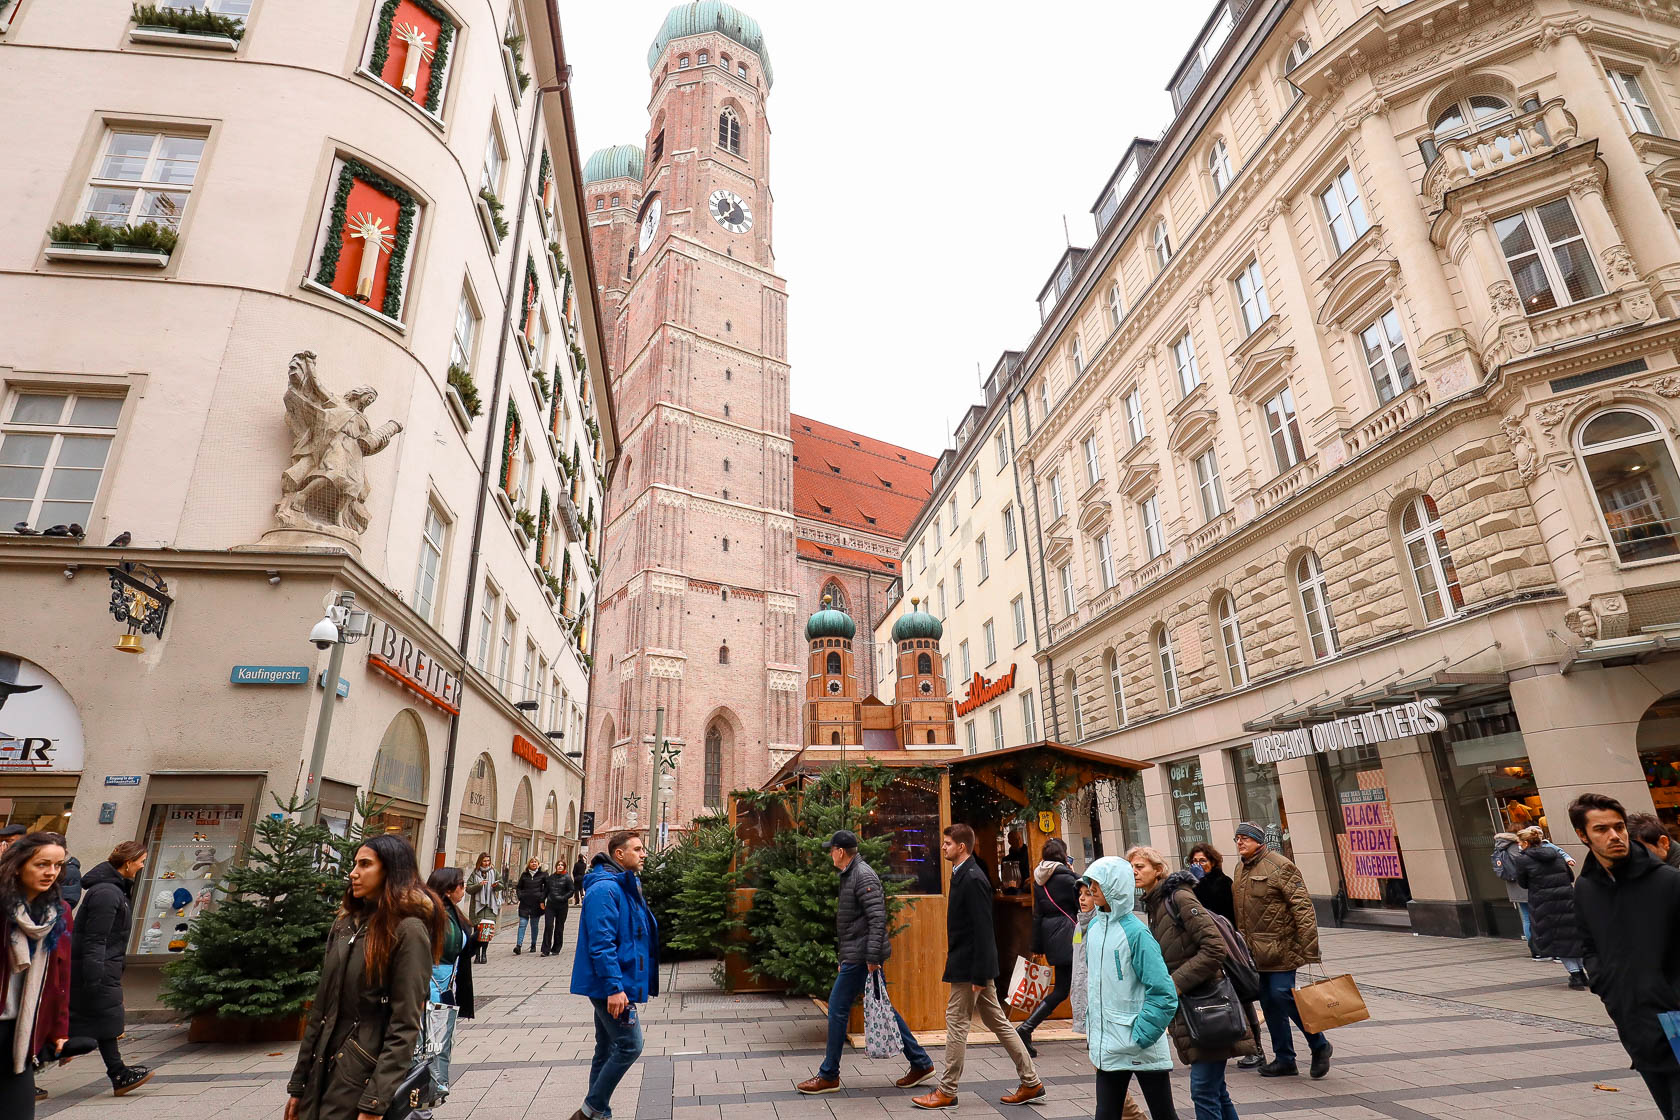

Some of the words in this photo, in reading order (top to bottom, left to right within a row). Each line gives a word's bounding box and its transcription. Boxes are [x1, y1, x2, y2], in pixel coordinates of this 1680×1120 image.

[238, 668, 301, 682] Kaufingerstr.
[381, 622, 462, 708] BREITER
[1252, 728, 1313, 764] URBAN
[1311, 697, 1447, 753] OUTFITTERS
[1170, 764, 1189, 780] OBEY
[1344, 804, 1382, 826] BLACK
[1350, 828, 1392, 851] FRIDAY
[1356, 856, 1400, 877] ANGEBOTE
[1017, 977, 1048, 1001] BAY
[1010, 991, 1041, 1012] ER
[413, 1042, 443, 1055] S.OM
